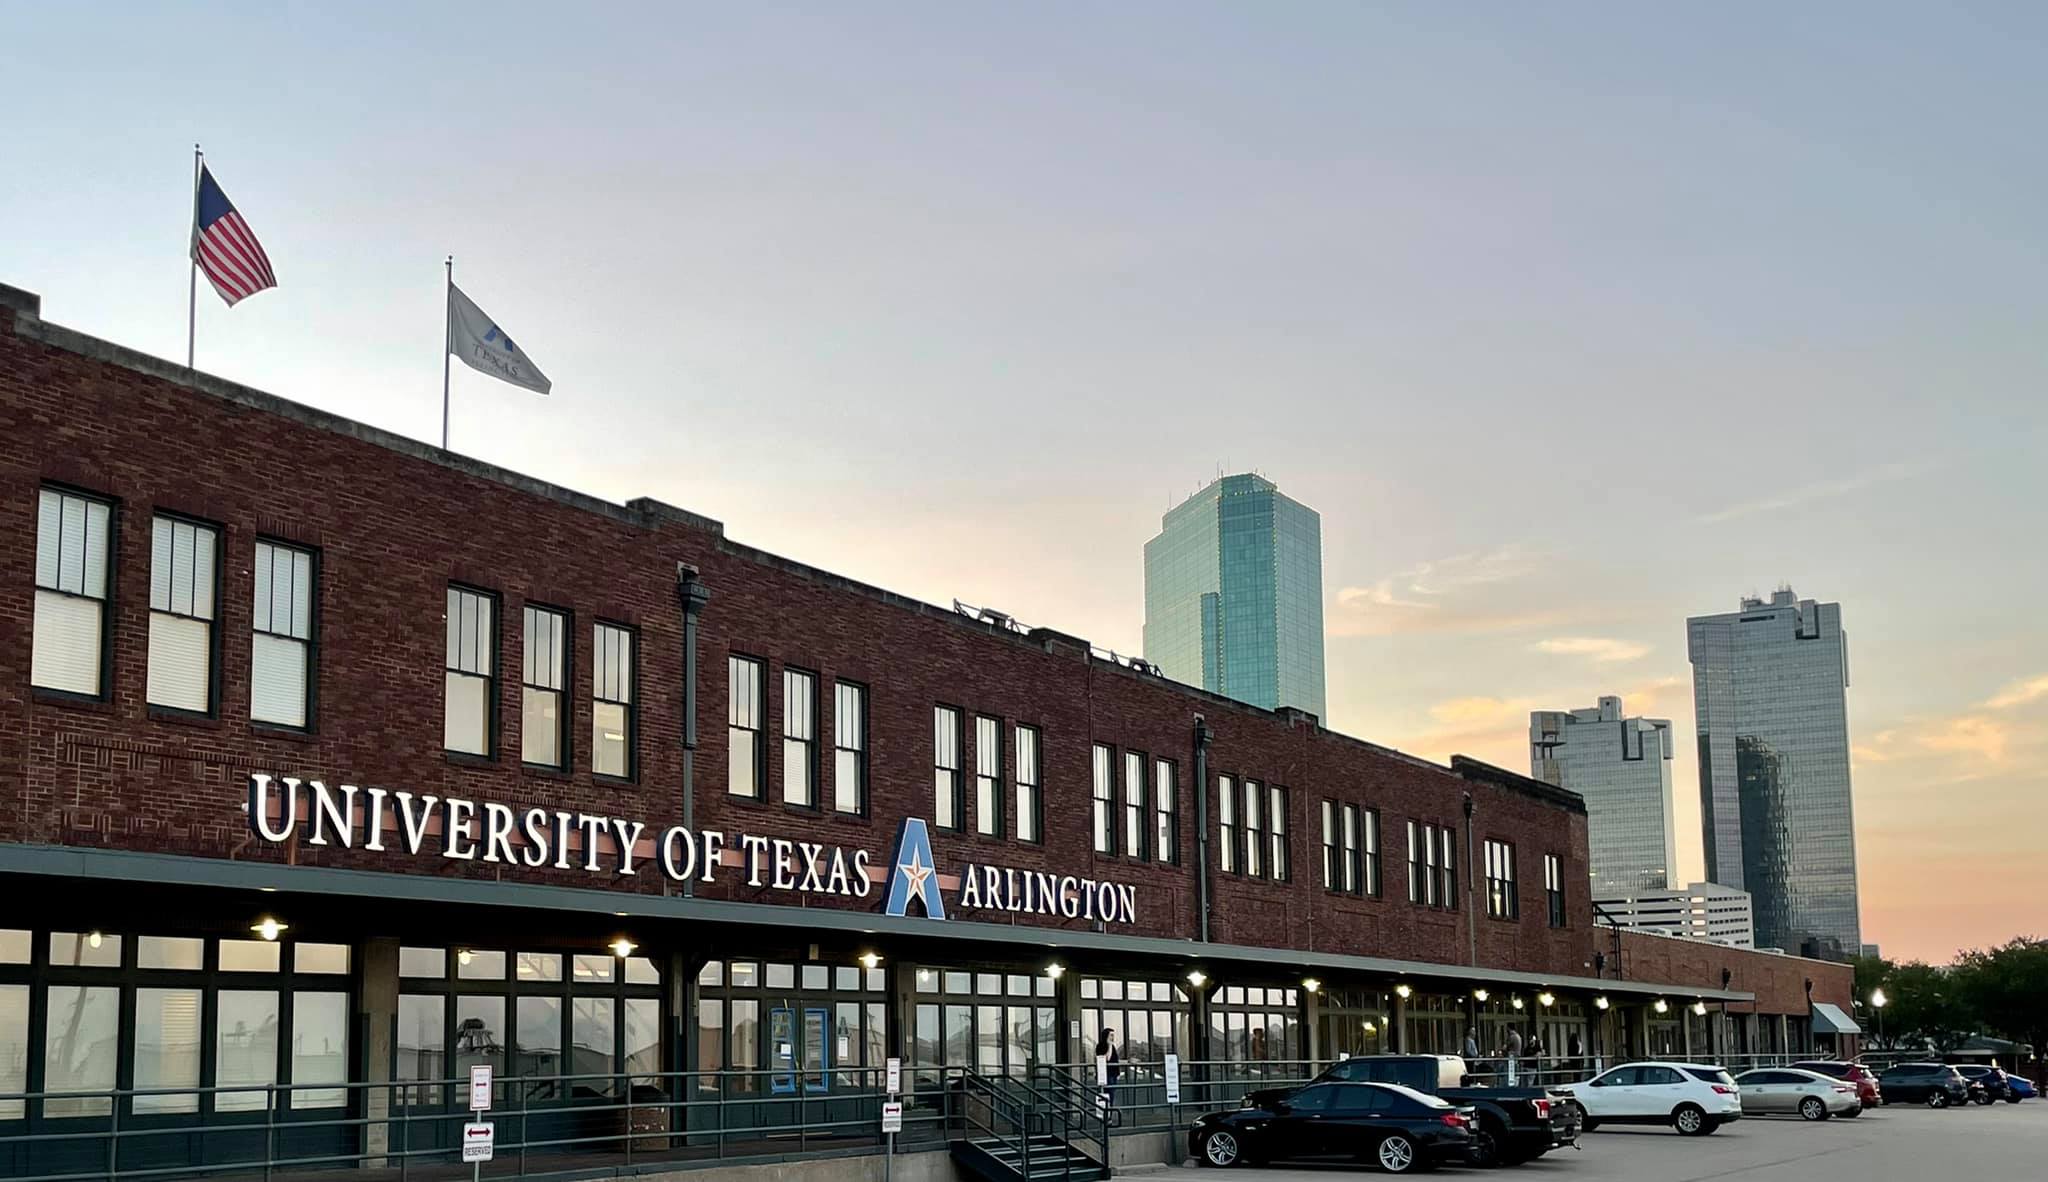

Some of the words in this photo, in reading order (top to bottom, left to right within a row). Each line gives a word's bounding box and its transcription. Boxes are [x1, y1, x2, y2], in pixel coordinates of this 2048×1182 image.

[250, 773, 645, 875] UNIVERSITY
[662, 825, 725, 882] OF
[742, 833, 871, 898] TEXAS
[960, 863, 1137, 925] ARLINGTON
